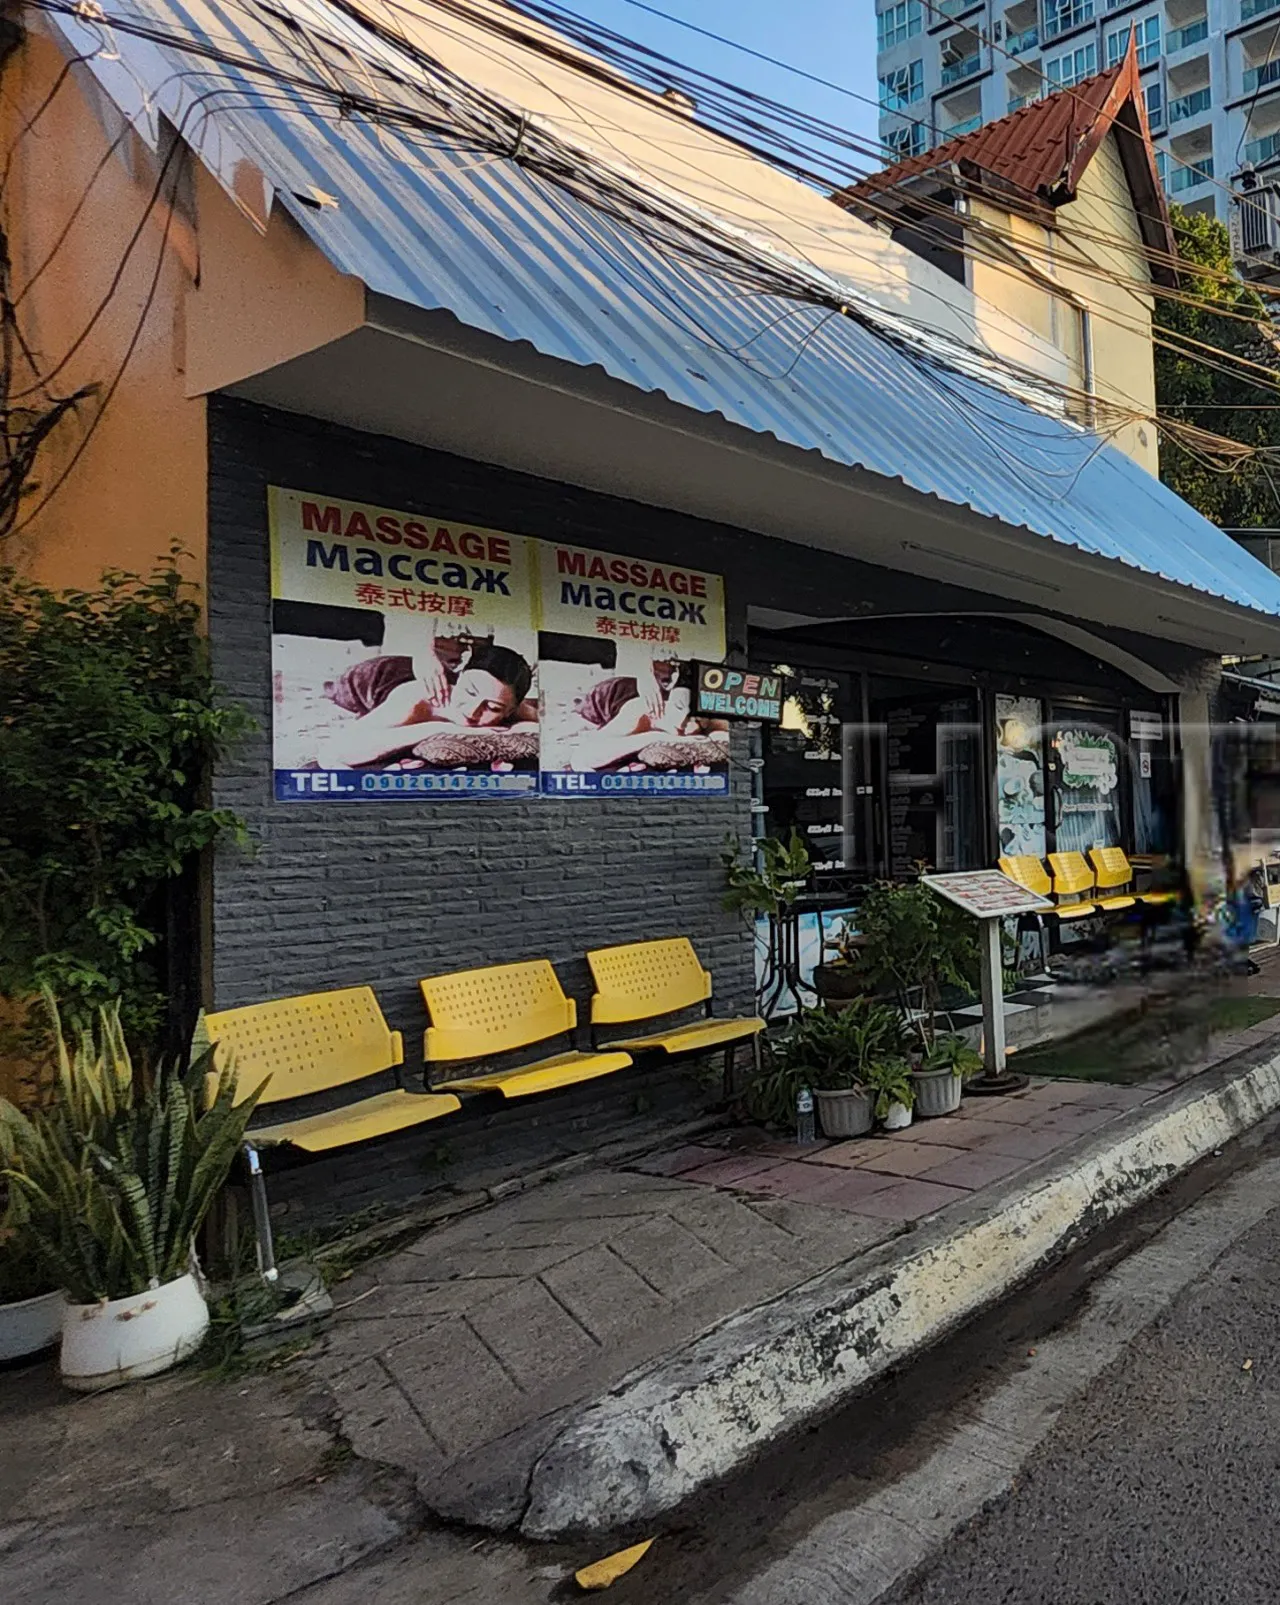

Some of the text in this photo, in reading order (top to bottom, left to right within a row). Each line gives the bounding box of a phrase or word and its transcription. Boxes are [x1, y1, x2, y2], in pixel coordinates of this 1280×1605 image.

[302, 501, 511, 565] MASSAGE
[556, 549, 707, 599] MASSAGE
[354, 582, 476, 617] 泰式按摩
[595, 615, 681, 644] 泰式按摩
[703, 668, 778, 698] OPEN
[699, 690, 780, 719] WELCOME
[290, 773, 503, 792] TEL. 0902614251
[547, 774, 597, 790] TEL.
